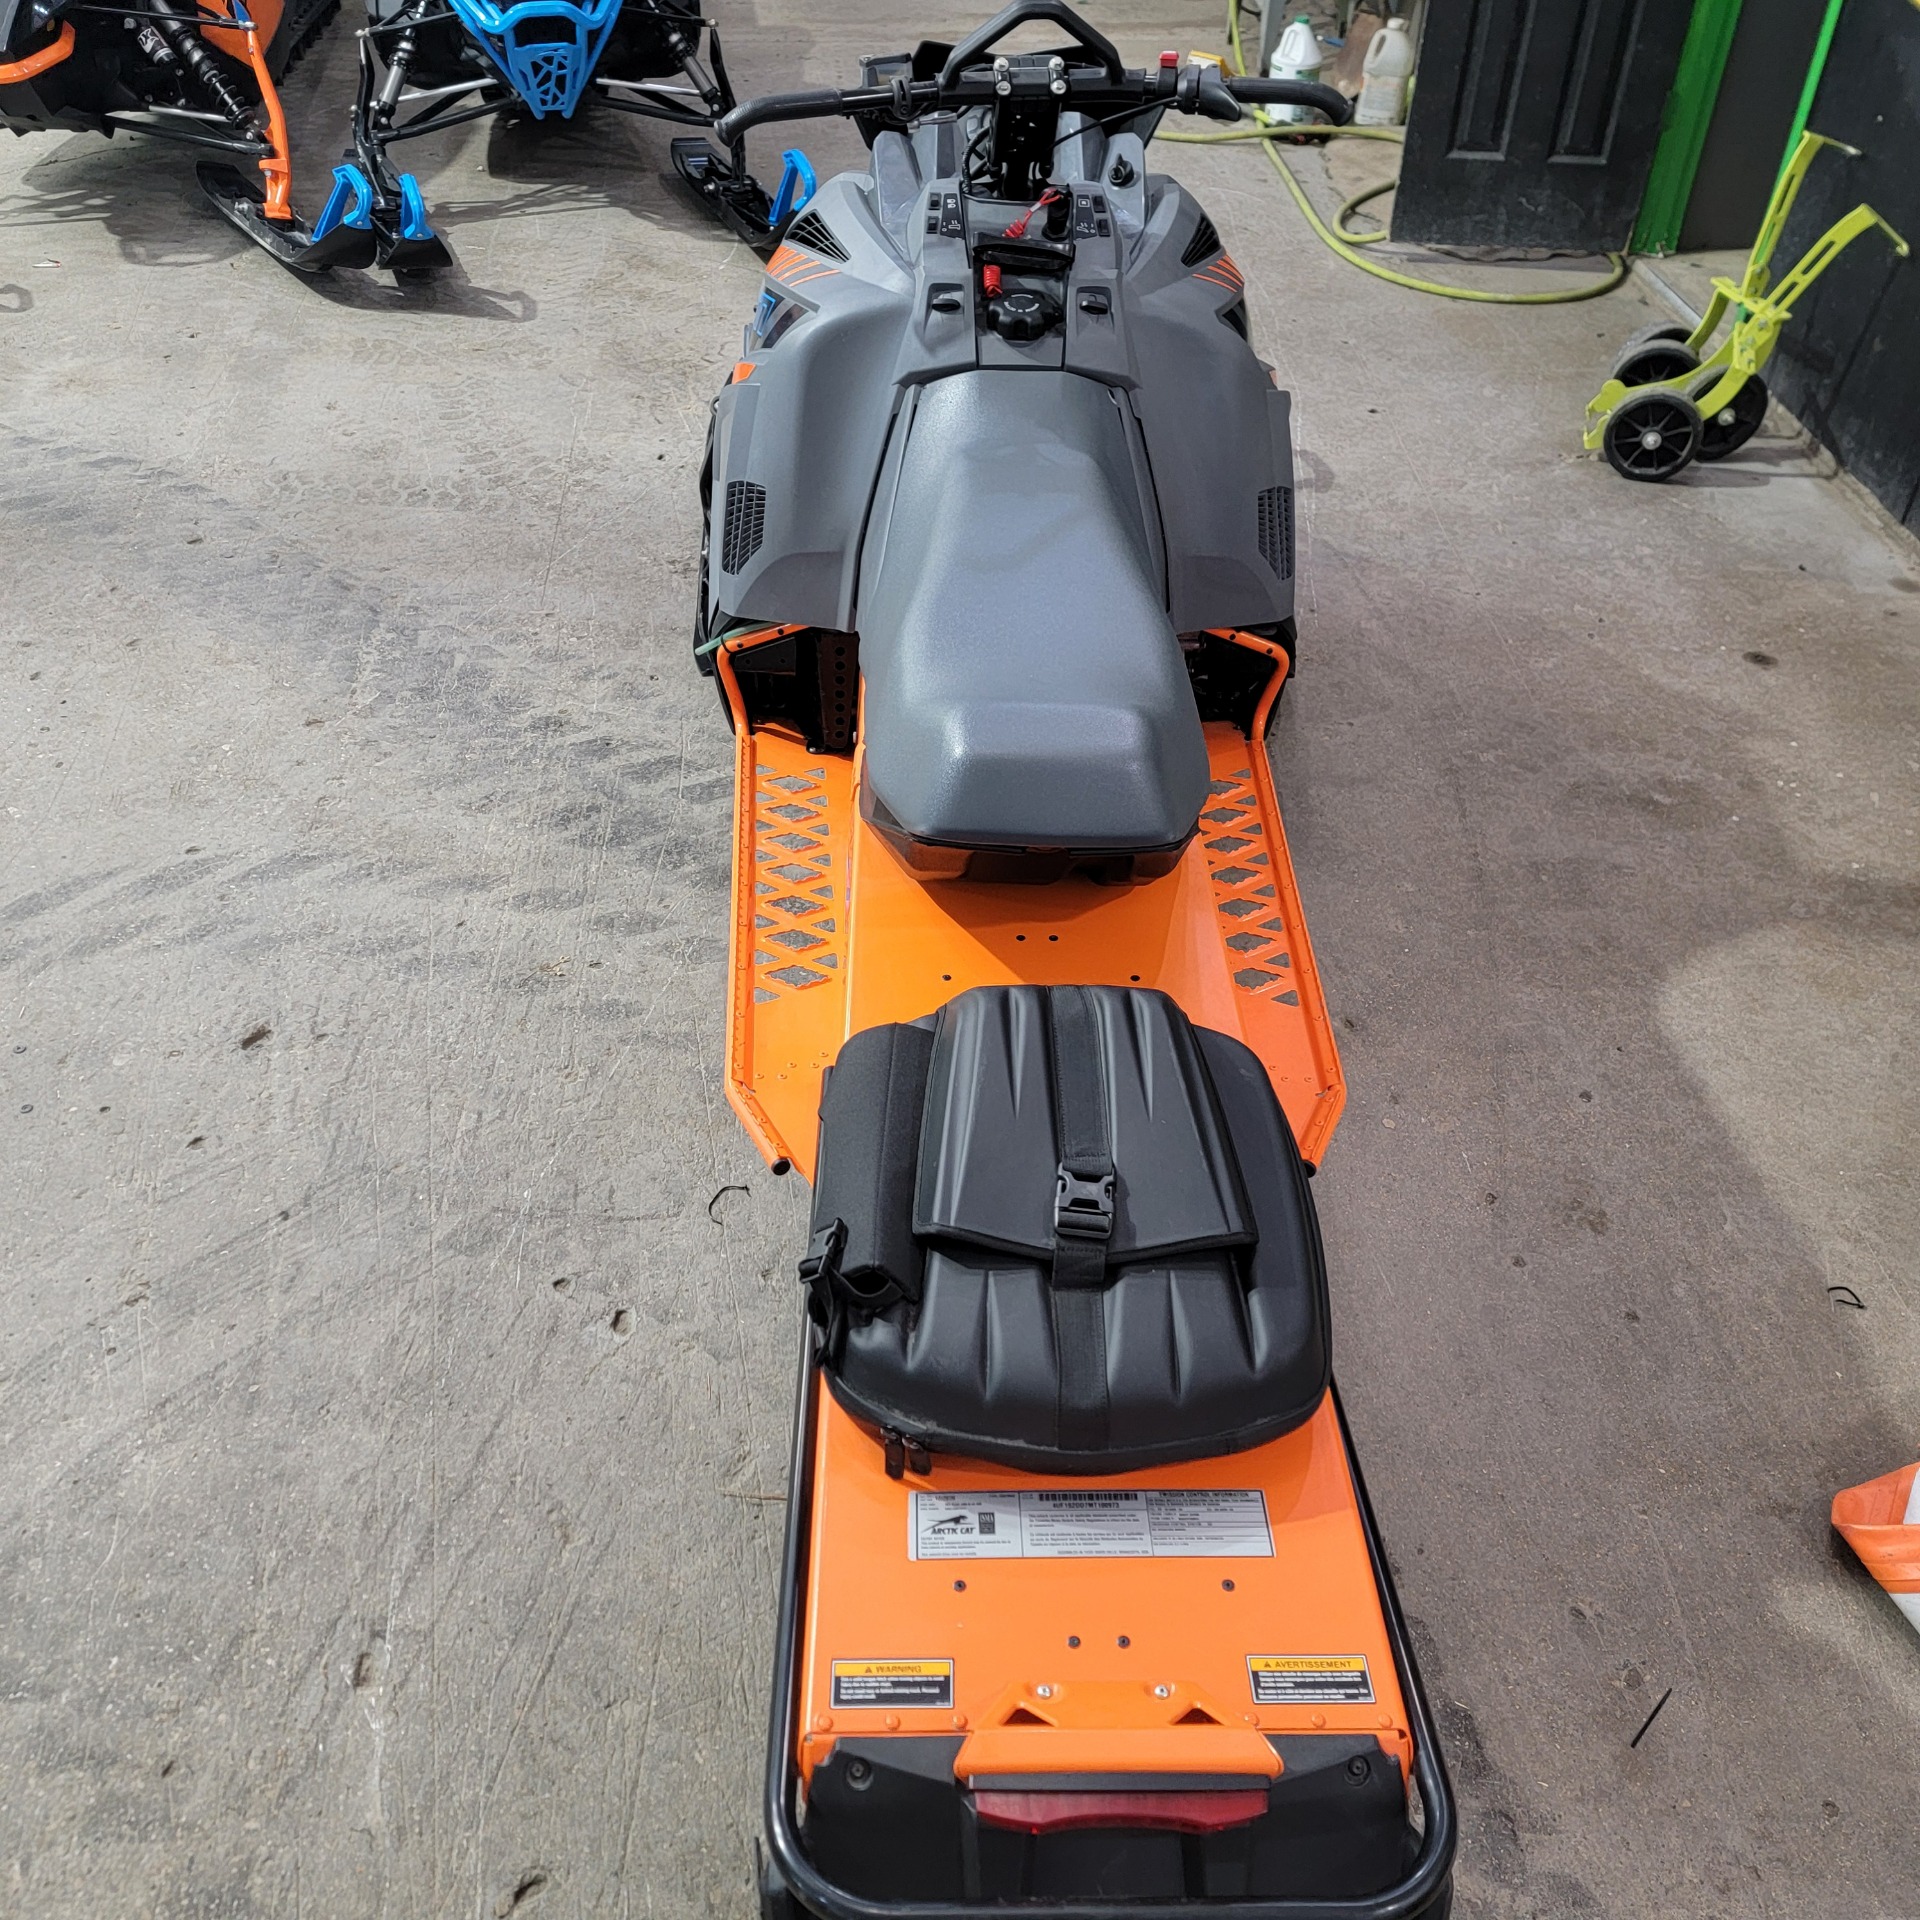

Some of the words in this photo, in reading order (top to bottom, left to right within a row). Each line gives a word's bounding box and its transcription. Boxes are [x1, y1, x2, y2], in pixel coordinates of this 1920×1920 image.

[930, 1527, 959, 1535] ARCTIC
[960, 1527, 976, 1535] CAT
[1275, 1660, 1352, 1668] AVERTISSEMENT
[875, 1665, 922, 1673] WARNING
